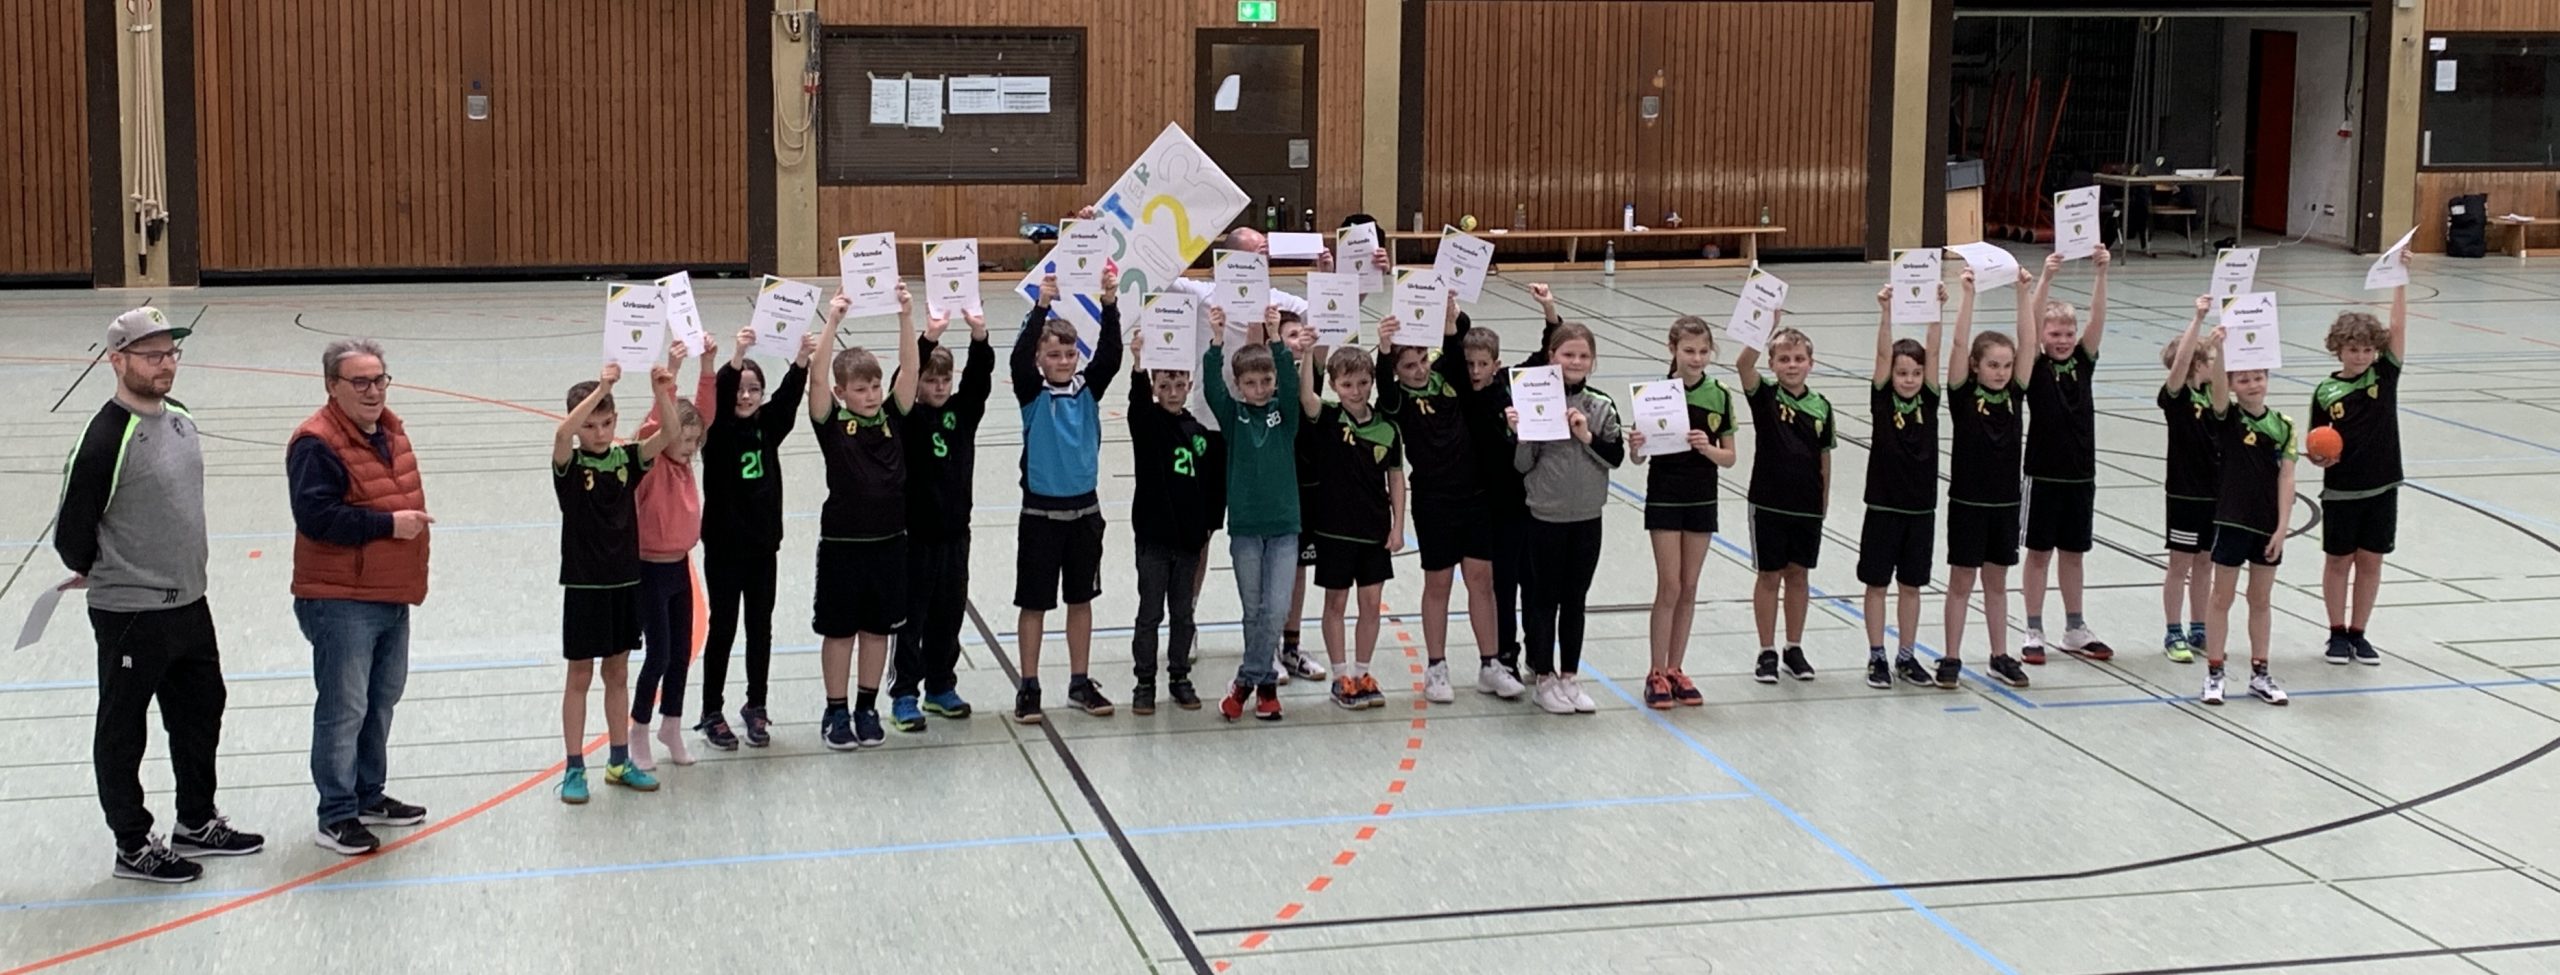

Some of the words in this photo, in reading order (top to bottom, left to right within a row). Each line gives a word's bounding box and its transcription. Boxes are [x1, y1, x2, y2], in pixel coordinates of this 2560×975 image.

[853, 250, 882, 258] Urkunde
[1407, 283, 1436, 291] Urkunde
[1155, 307, 1184, 315] Urkunde
